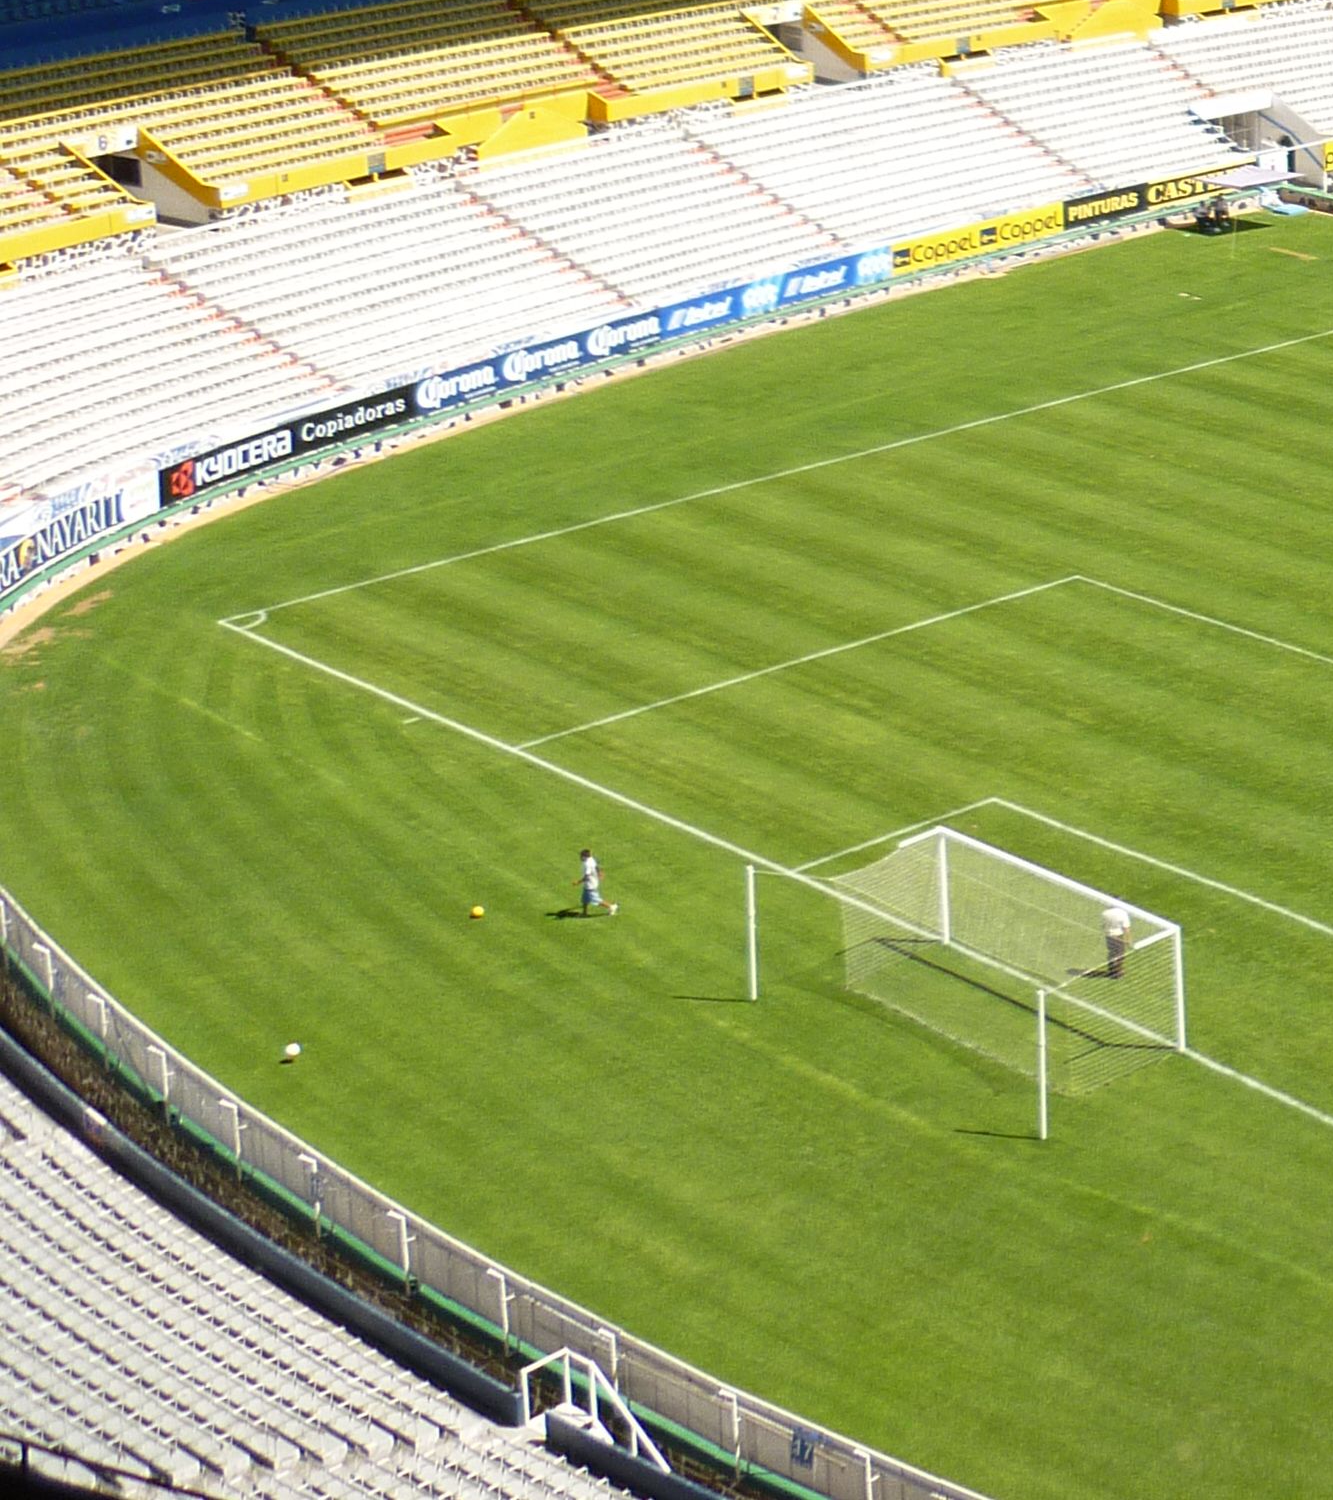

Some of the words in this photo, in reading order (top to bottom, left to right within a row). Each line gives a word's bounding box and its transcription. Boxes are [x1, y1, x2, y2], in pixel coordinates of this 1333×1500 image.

[999, 211, 1063, 242] Coppel
[1068, 192, 1139, 222] PINTURAS
[911, 232, 978, 263] Coppel
[587, 316, 661, 357] Corona
[502, 340, 583, 382] Corona
[416, 365, 500, 410] Corona
[195, 428, 293, 487] KYOCERA
[302, 397, 406, 443] Copiadoras
[33, 488, 124, 565] NAYARIT
